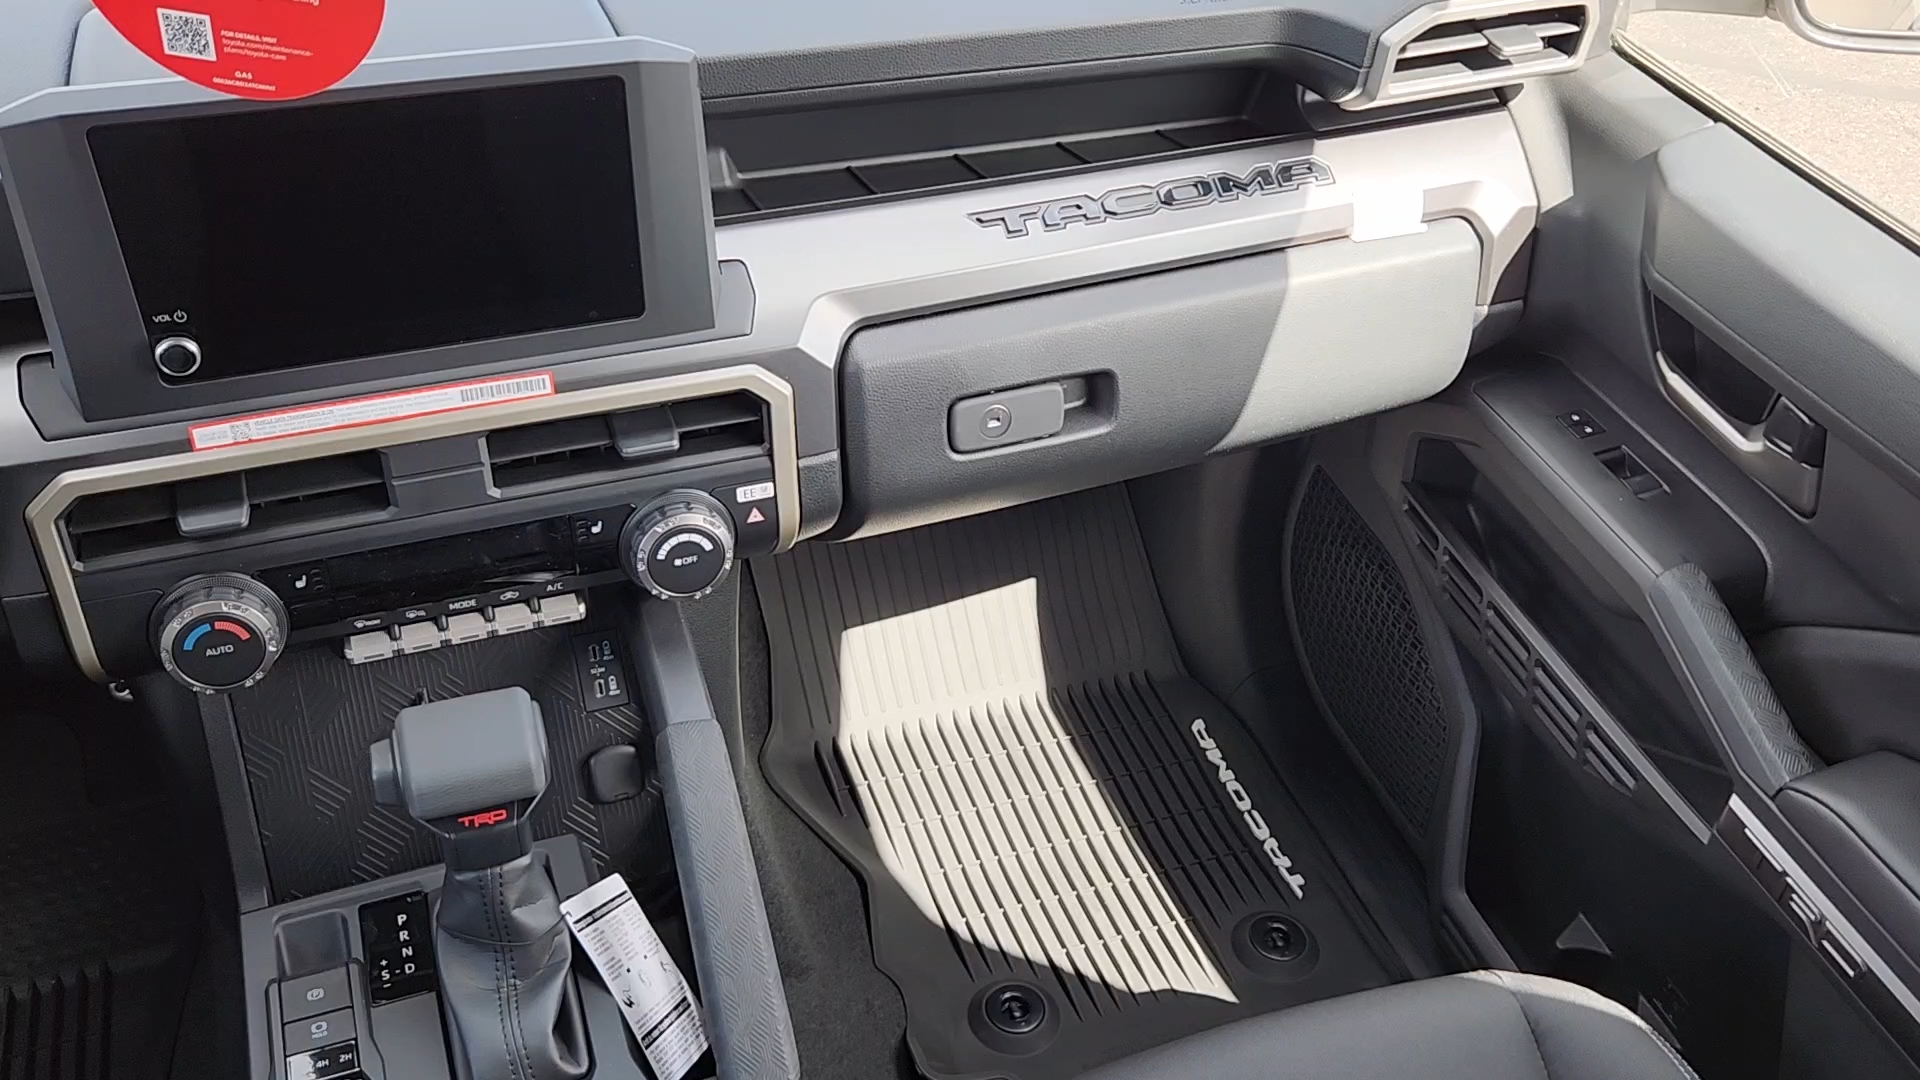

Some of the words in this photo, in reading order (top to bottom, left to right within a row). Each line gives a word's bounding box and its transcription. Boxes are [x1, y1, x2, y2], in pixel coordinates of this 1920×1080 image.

[221, 29, 235, 38] FOR
[234, 70, 253, 80] GAS
[966, 155, 1336, 239] TACOMA
[152, 314, 173, 323] VOL
[743, 488, 756, 500] EE
[682, 555, 699, 565] OFF
[546, 582, 564, 592] A/C
[448, 598, 478, 611] MODE
[205, 644, 235, 657] AUTO
[1191, 718, 1306, 900] TACOMA
[457, 809, 507, 828] TRD
[397, 914, 407, 926] P
[400, 930, 410, 942] R
[402, 946, 413, 958] N
[315, 1058, 329, 1068] 4H
[339, 1052, 352, 1063] 2H
